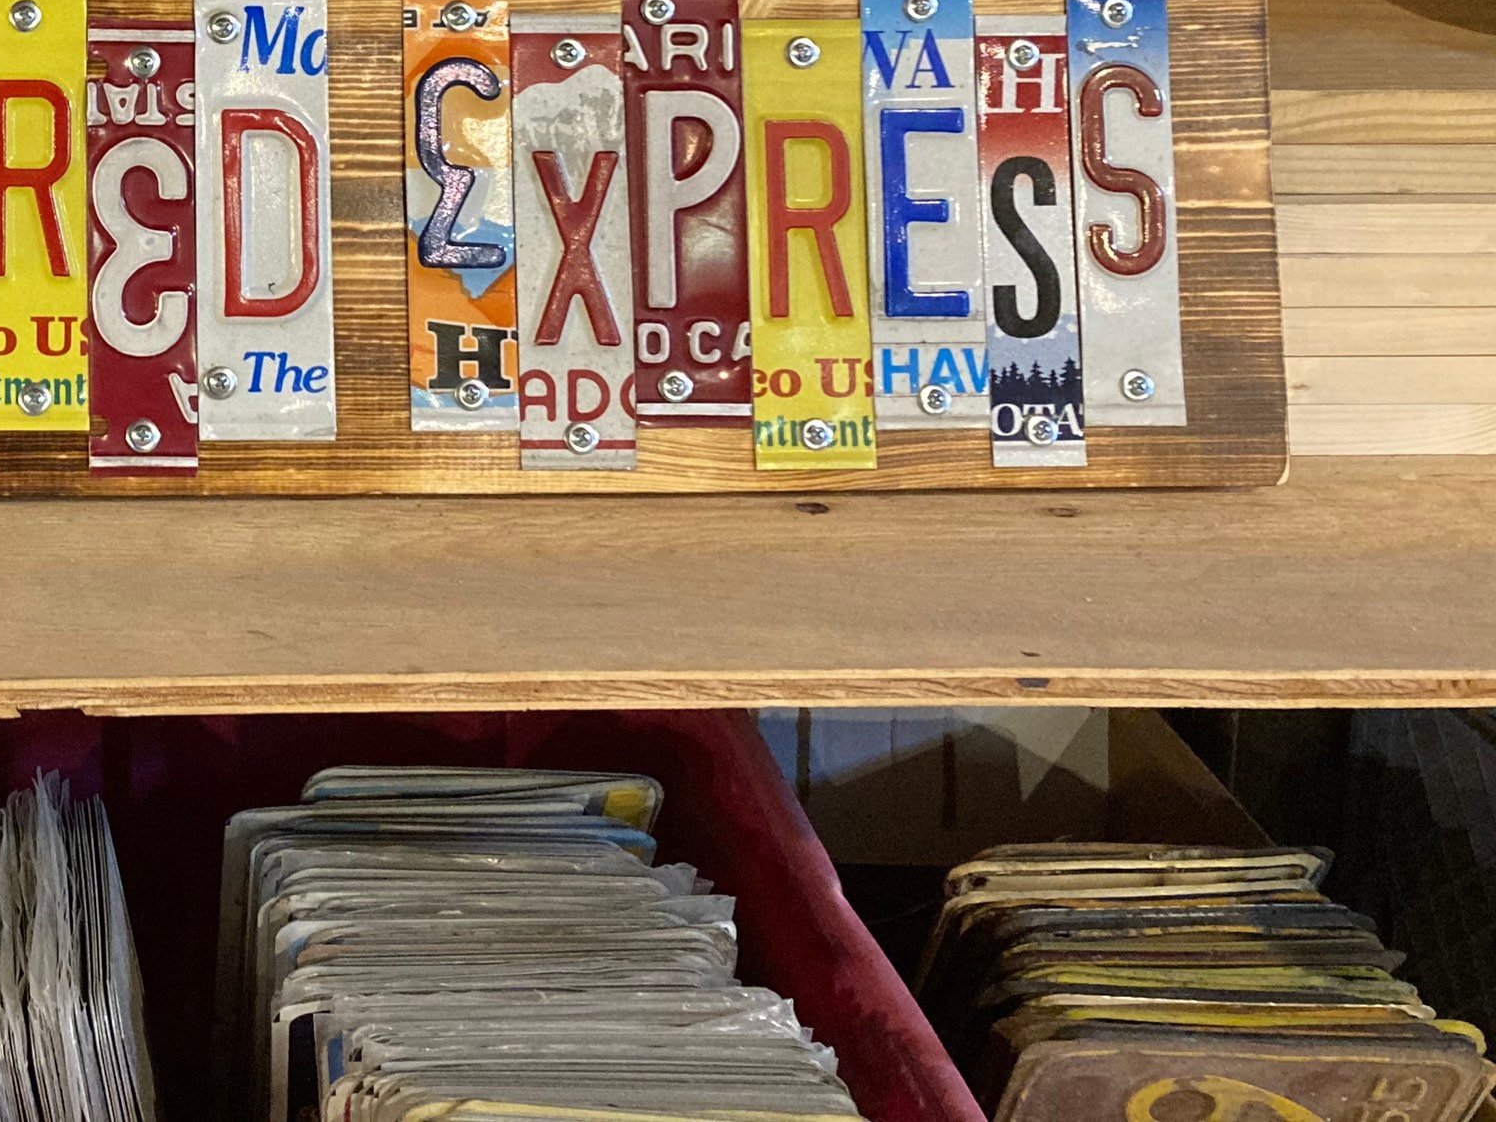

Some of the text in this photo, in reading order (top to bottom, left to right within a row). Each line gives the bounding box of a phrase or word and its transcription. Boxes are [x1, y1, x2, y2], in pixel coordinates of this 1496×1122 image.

[30, 316, 87, 357] U
[243, 351, 328, 394] The
[814, 358, 874, 398] U
